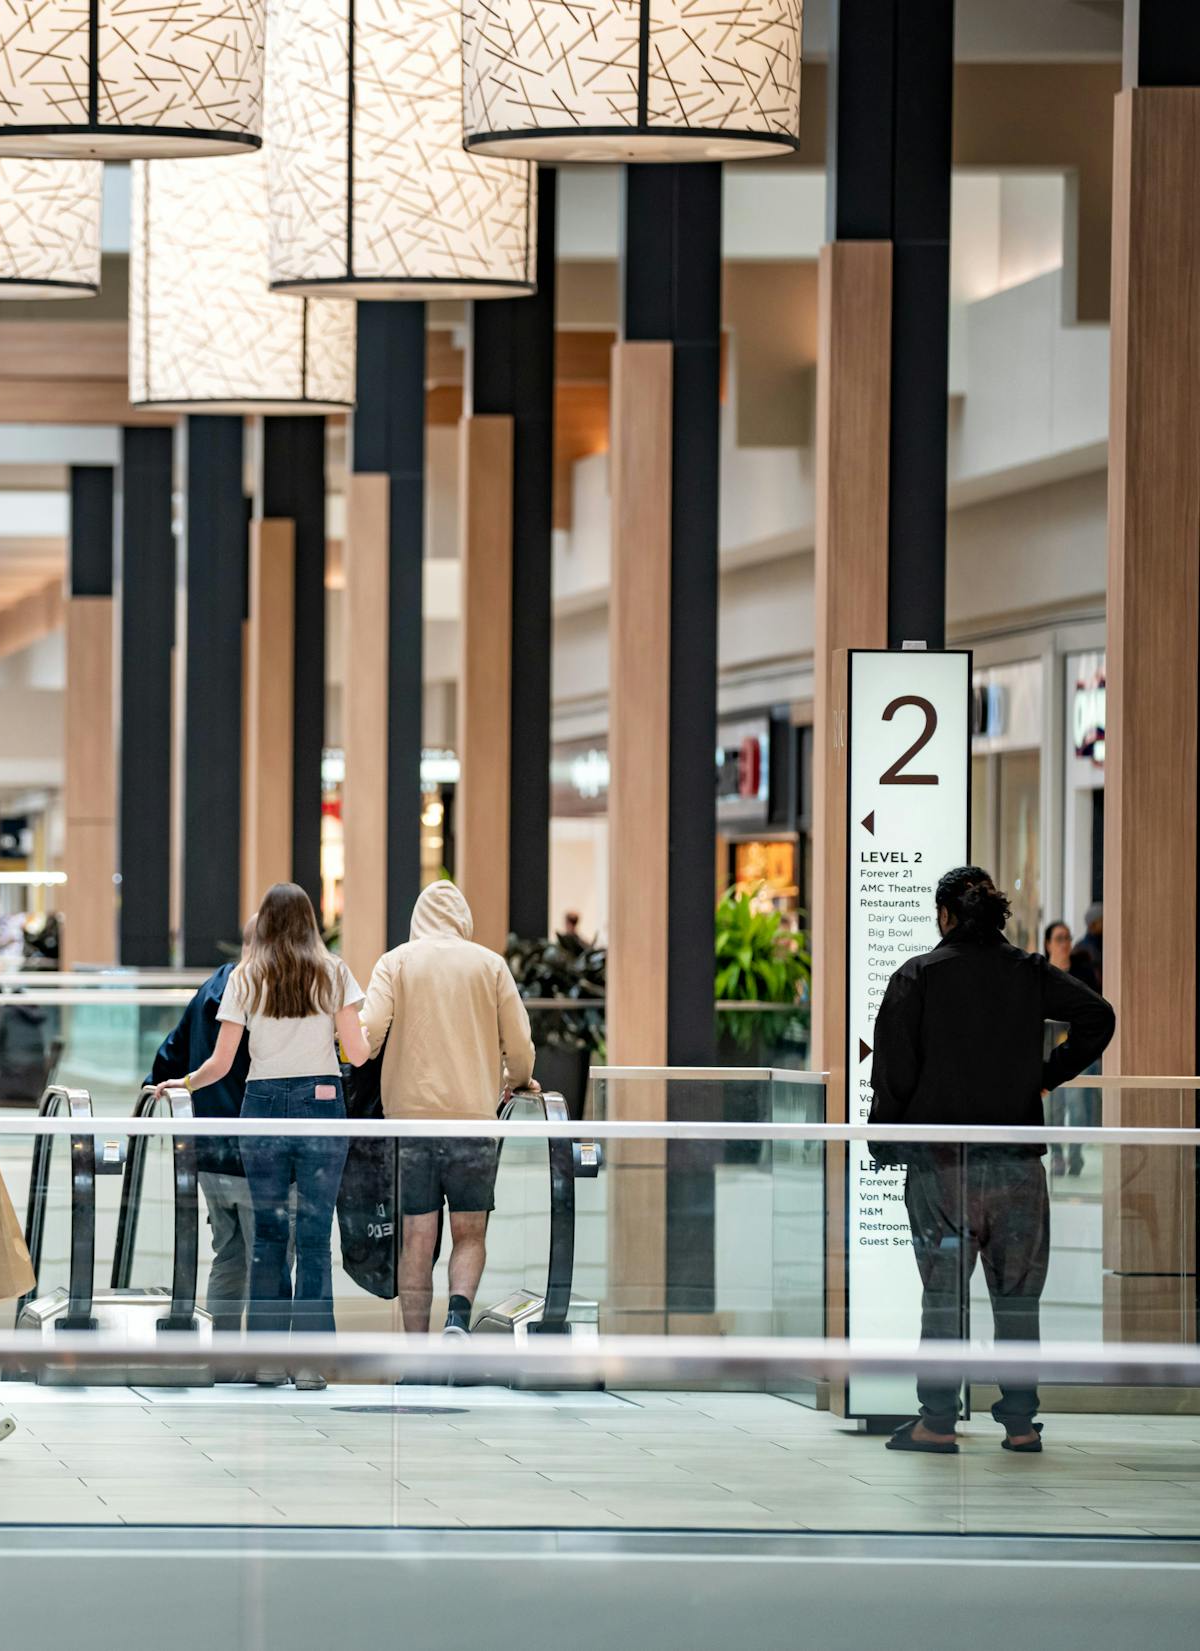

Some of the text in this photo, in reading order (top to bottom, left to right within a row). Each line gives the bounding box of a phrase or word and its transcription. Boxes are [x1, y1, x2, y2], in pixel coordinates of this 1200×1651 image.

[879, 695, 939, 785] 2
[860, 852, 923, 863] LEVEL 2
[860, 870, 913, 878] Forever 21
[860, 885, 932, 893] AMC Theatres
[860, 899, 920, 908] Restaurants
[868, 914, 932, 924] Dairy Queen
[868, 928, 913, 939] Big Bowl
[868, 943, 933, 954] Maya Cuisine
[867, 957, 897, 967] Crave
[859, 1178, 898, 1186] Forever
[859, 1192, 879, 1201] Von
[859, 1208, 883, 1216] H&M
[859, 1237, 889, 1246] Guest
